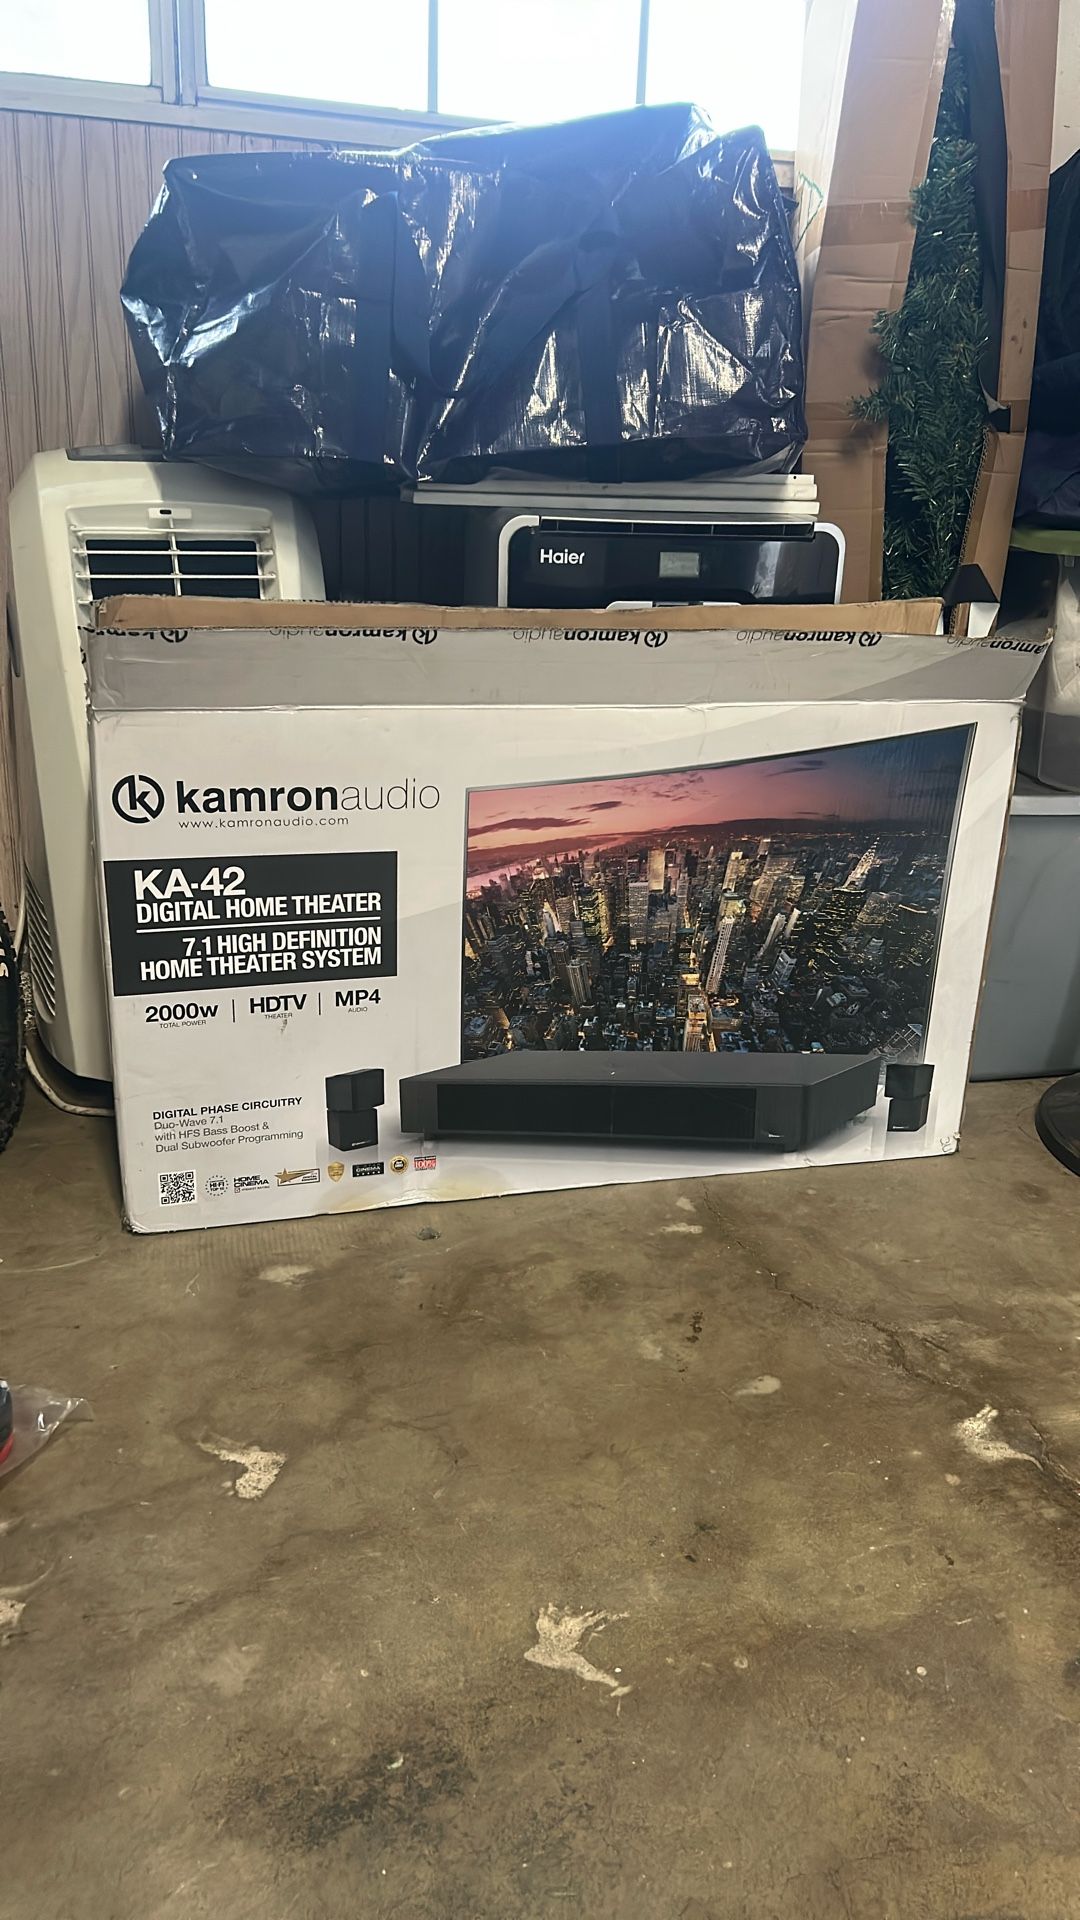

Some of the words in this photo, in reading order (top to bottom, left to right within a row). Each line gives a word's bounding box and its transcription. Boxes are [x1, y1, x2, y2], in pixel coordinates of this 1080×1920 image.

[540, 549, 585, 565] Haier
[176, 778, 440, 814] kamronaudio
[178, 815, 349, 829] www.kamronaudio.com
[134, 866, 247, 900] KA-42
[136, 900, 221, 924] DIGITAL
[225, 896, 288, 919] HOME
[291, 892, 382, 915] THEATER
[182, 936, 212, 957] 7.1
[217, 933, 267, 955] HIGH
[272, 927, 382, 951] DEFINITION
[140, 957, 202, 981] HOME
[209, 952, 297, 976] THEATER
[302, 947, 382, 969] SYSTEM
[250, 994, 308, 1014] HDTV
[335, 989, 381, 1007] MP4
[145, 1002, 219, 1023] 2000w
[264, 1012, 293, 1020] THEATER
[159, 1021, 180, 1029] TOTAL
[182, 1019, 207, 1027] POWER
[153, 1108, 197, 1120] DIGITAL
[200, 1103, 239, 1115] PHASE
[242, 1097, 303, 1111] CIRCUITRY
[154, 1117, 207, 1130] Duo-Wave
[210, 1115, 224, 1124] 7.1
[155, 1130, 176, 1141] with
[178, 1129, 201, 1139] HFS
[203, 1127, 228, 1136] Bass
[230, 1123, 260, 1134] Boost
[262, 1121, 270, 1130] &
[155, 1143, 179, 1153] Dual
[181, 1137, 236, 1150] Subwoofer
[238, 1130, 304, 1145] Programming
[233, 1175, 261, 1183] HOME
[233, 1179, 270, 1188] CINEMA
